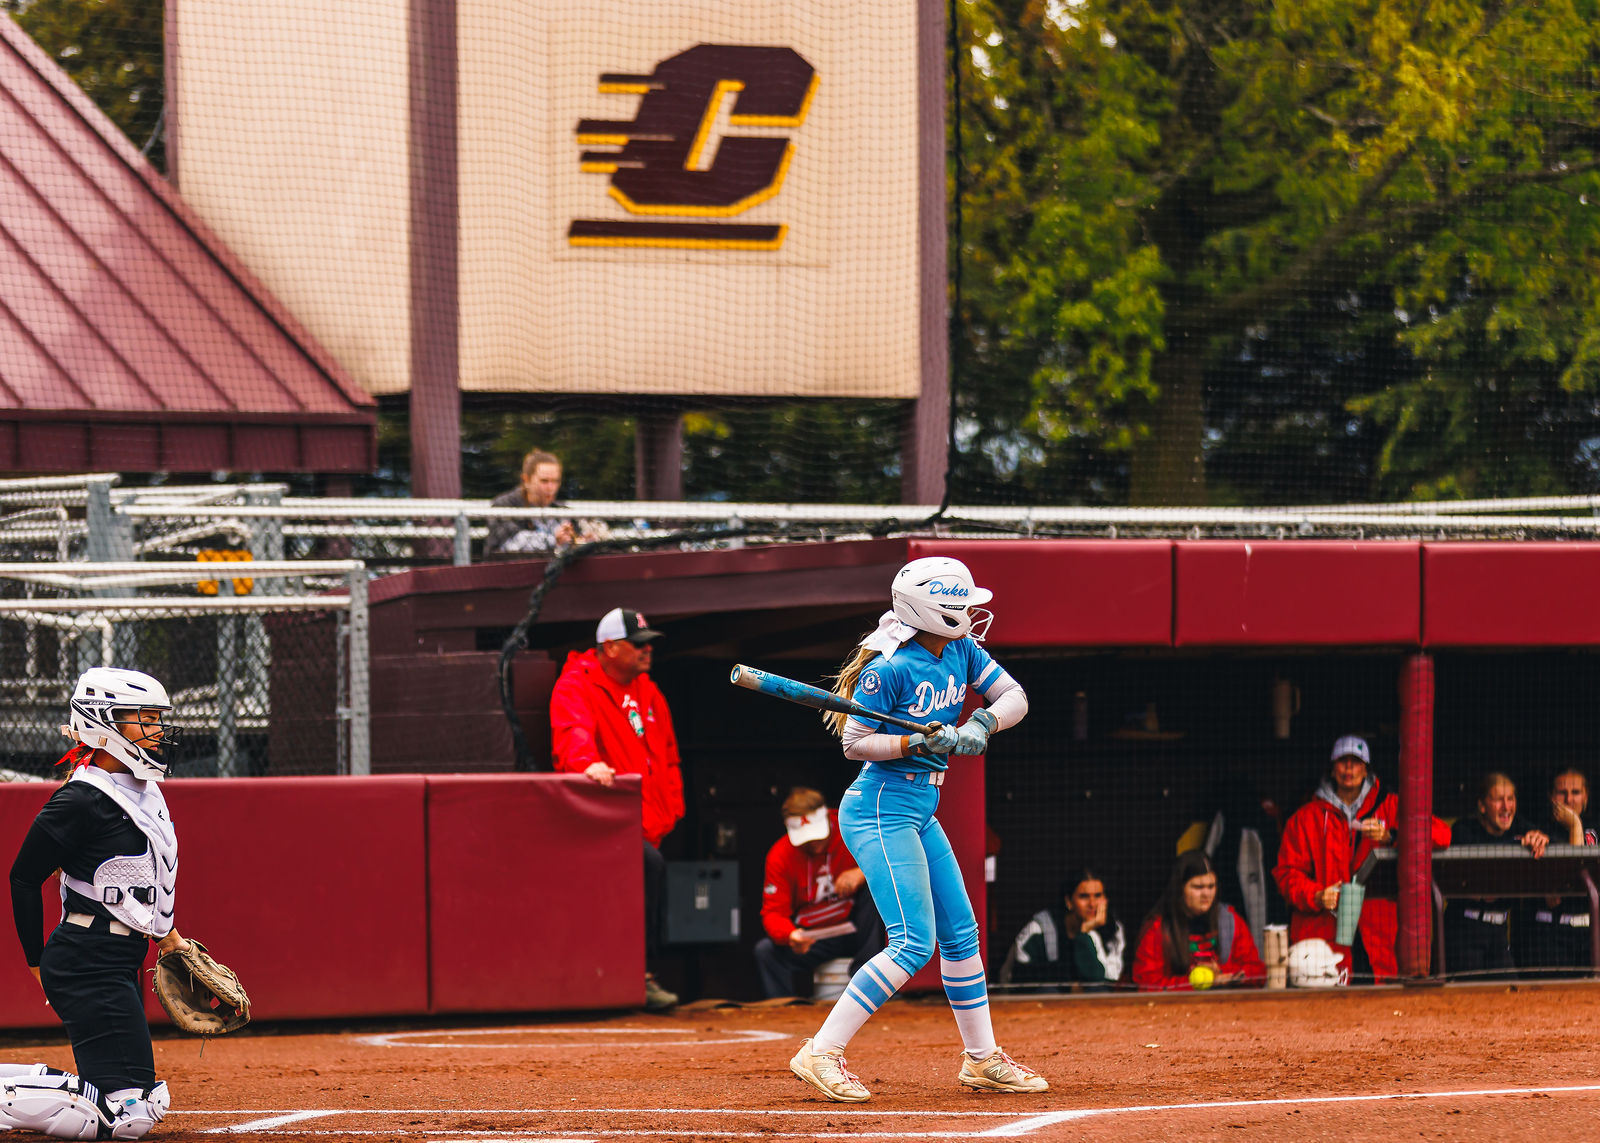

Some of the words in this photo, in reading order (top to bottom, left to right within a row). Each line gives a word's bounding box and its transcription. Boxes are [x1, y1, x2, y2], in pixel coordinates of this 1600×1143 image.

[576, 42, 820, 217] C
[929, 581, 968, 597] Dukes
[907, 674, 967, 718] Duke
